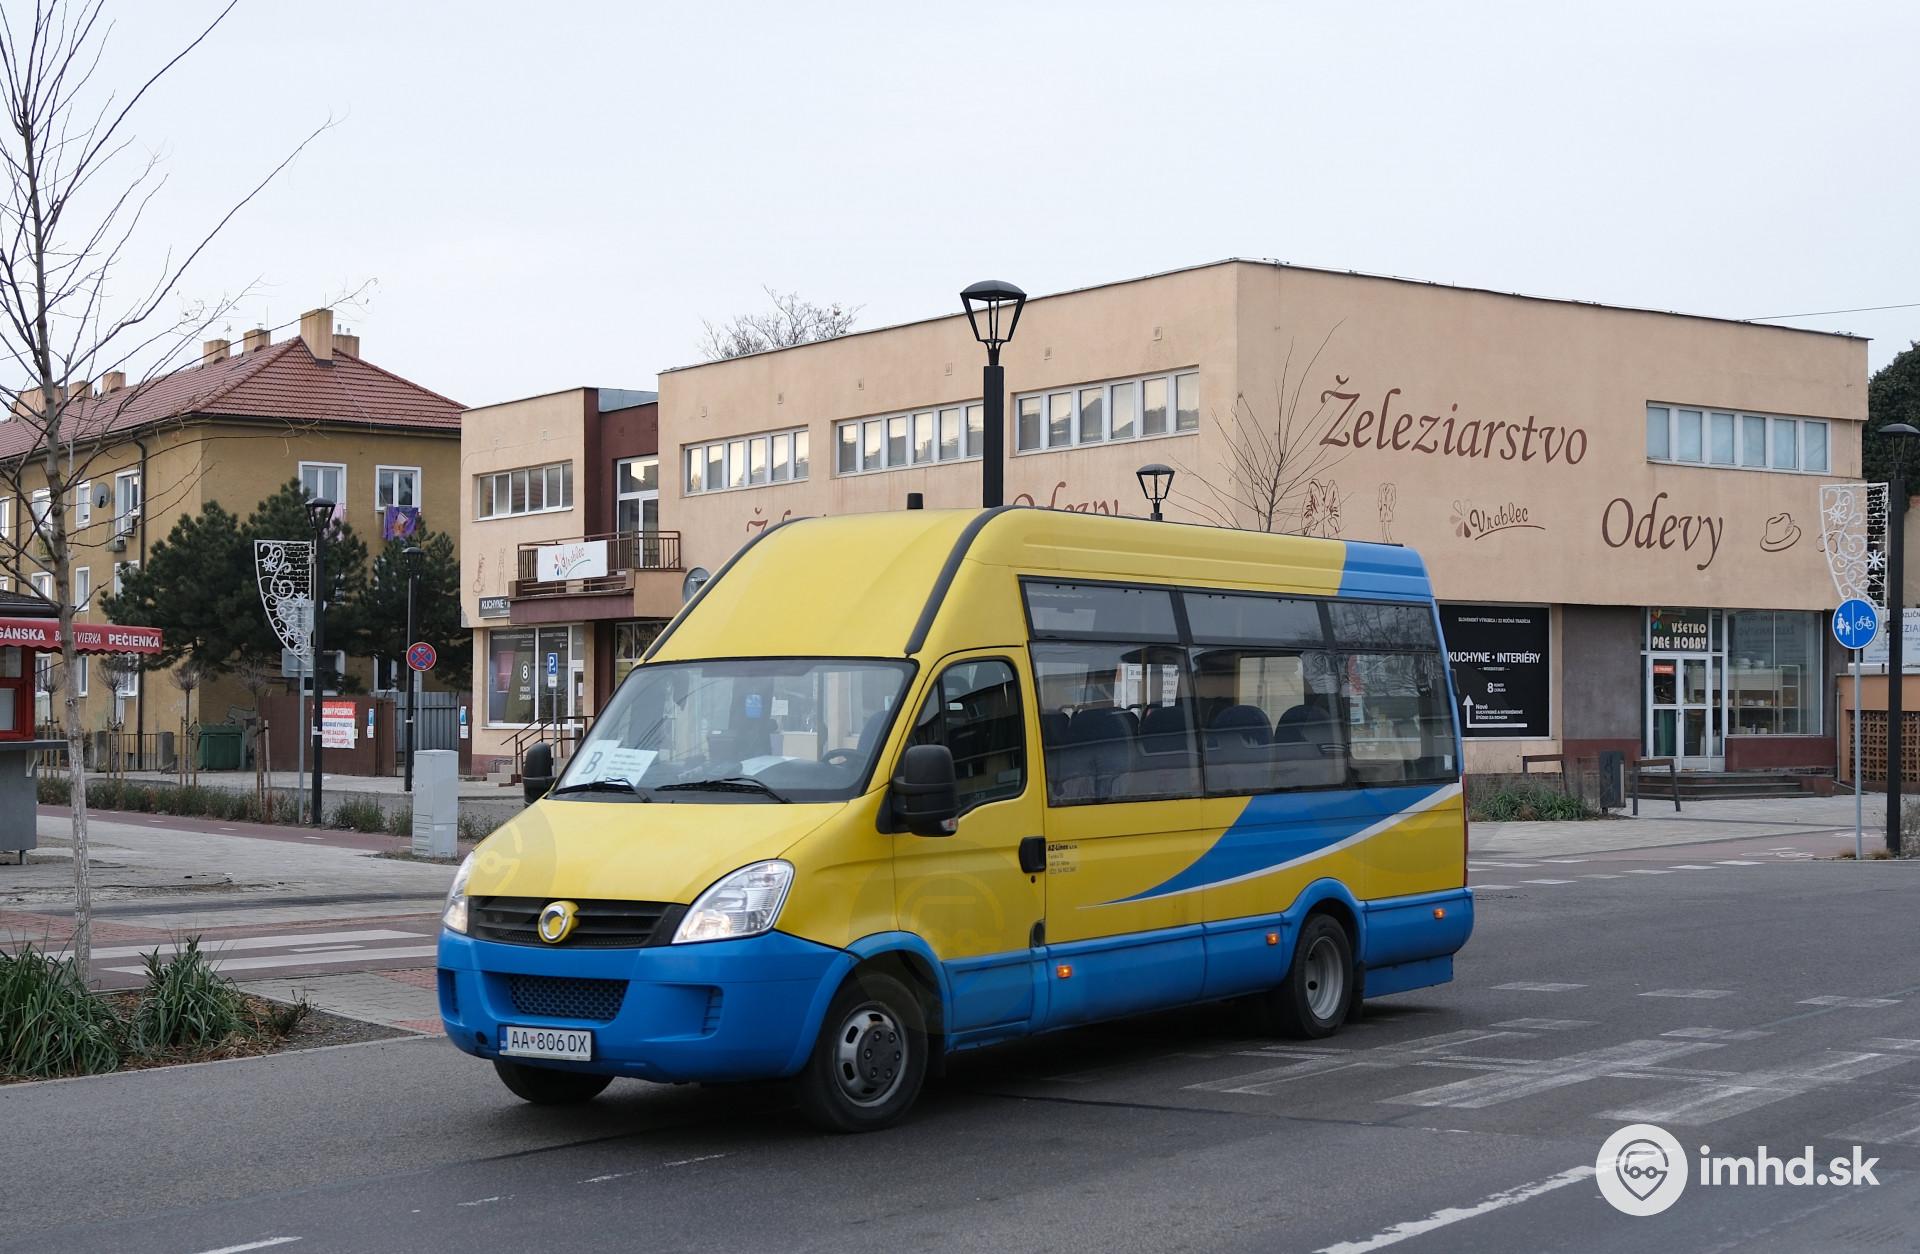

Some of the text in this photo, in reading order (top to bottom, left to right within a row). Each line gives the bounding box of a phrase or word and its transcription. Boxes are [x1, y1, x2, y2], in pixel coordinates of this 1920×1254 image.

[1318, 374, 1588, 466] Železiarstvo
[1469, 502, 1529, 533] Vrablec
[1601, 491, 1724, 571] Odevy
[1671, 620, 1707, 634] VŠETKO
[77, 630, 102, 644] VIERKA
[108, 632, 160, 648] PEČIENKA
[1652, 635, 1707, 649] PRE HOBBY
[548, 656, 555, 672] P
[1448, 650, 1541, 664] KUCHYNE INTERIÉRY
[522, 665, 528, 680] 8
[1487, 682, 1494, 693] 8
